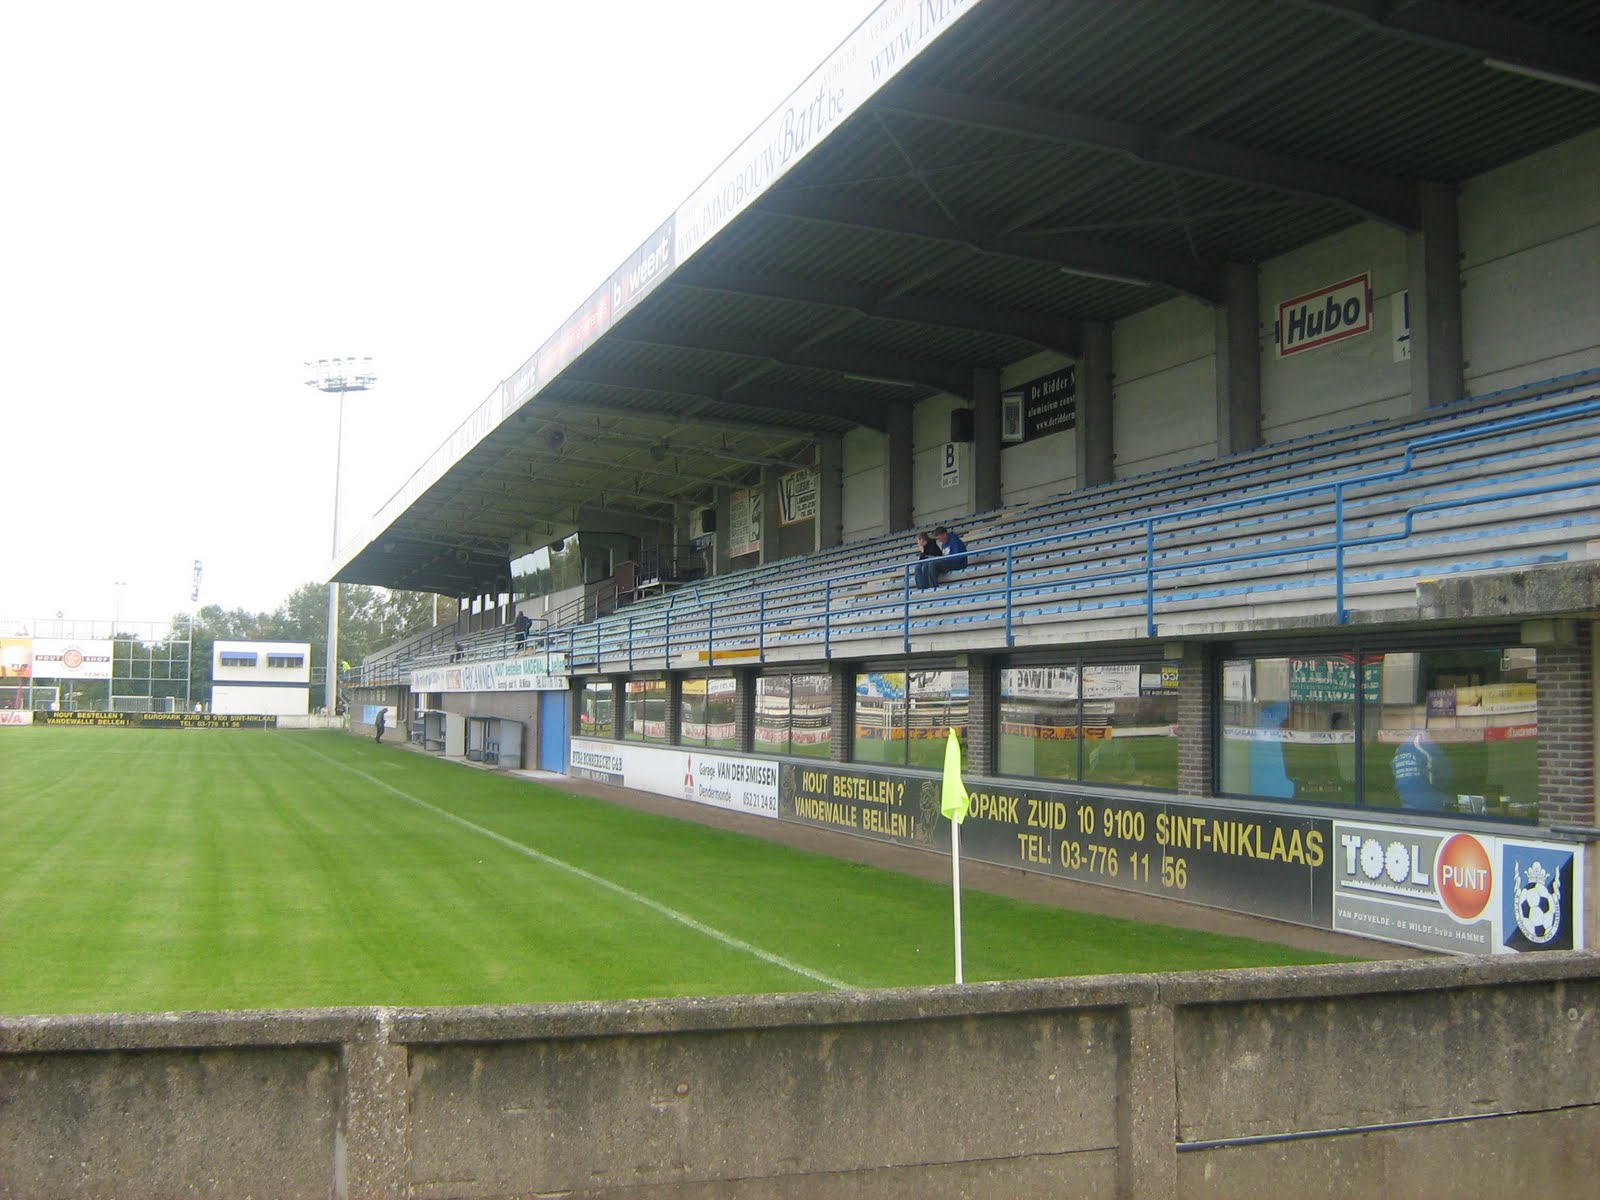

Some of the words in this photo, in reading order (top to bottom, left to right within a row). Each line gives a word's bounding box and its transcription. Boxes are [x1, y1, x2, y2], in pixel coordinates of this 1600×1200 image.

[1288, 296, 1360, 344] Hubo
[1031, 386, 1041, 400] De
[1043, 377, 1068, 397] Ridder
[946, 444, 955, 469] B
[143, 713, 182, 721] EUROPARK
[184, 714, 201, 722] ZUID
[699, 762, 716, 780] Garage
[717, 761, 731, 780] VAN
[732, 764, 745, 782] DER
[746, 765, 776, 786] SMISSEN
[802, 771, 828, 794] HOUT
[699, 784, 732, 803] Dendermonde
[743, 791, 752, 807] 052
[753, 793, 760, 808] 21
[760, 794, 768, 809] 24
[768, 796, 776, 811] 82
[795, 796, 857, 828] VANDEWALLE
[966, 793, 1019, 825] OPARK
[1028, 799, 1067, 831] ZUID
[1077, 806, 1095, 835] 10
[1104, 808, 1145, 842] 9100
[1156, 813, 1324, 868] SINT-NIKLAAS
[1060, 839, 1119, 877] 03-776
[1130, 851, 1149, 883] 11
[1163, 856, 1187, 890] 56
[1341, 834, 1429, 886] TOOL
[1442, 864, 1487, 891] PUNT
[1338, 908, 1352, 919] VAN
[1353, 911, 1390, 926] PUYVELDE
[1397, 920, 1407, 929] DE
[1409, 922, 1433, 934] WILDE
[1455, 929, 1485, 944] HAMME
